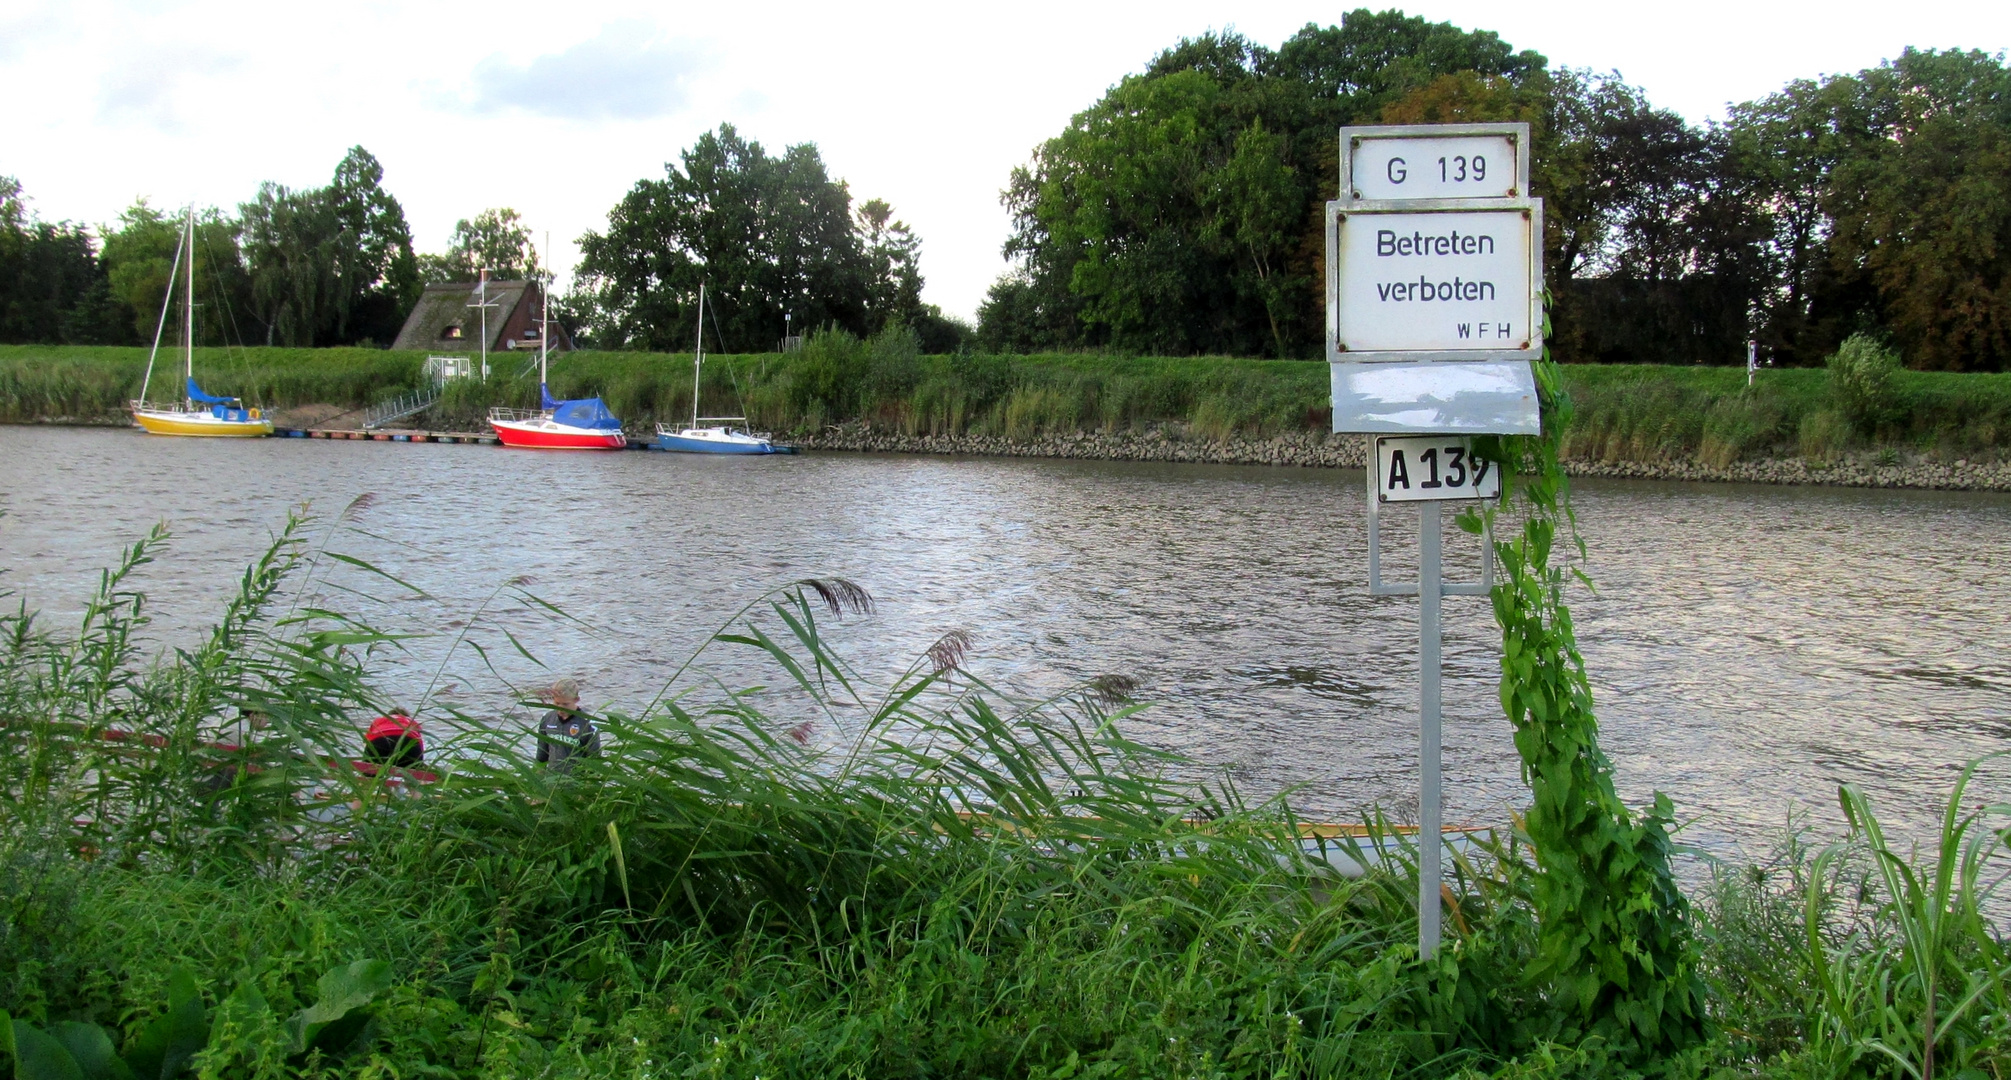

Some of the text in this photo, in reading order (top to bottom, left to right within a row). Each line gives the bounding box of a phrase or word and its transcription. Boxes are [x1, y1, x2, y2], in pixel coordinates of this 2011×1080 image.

[1388, 155, 1486, 184] G 139
[1377, 230, 1494, 257] Betreten
[1377, 275, 1495, 302] verboten
[1388, 450, 1410, 489] A
